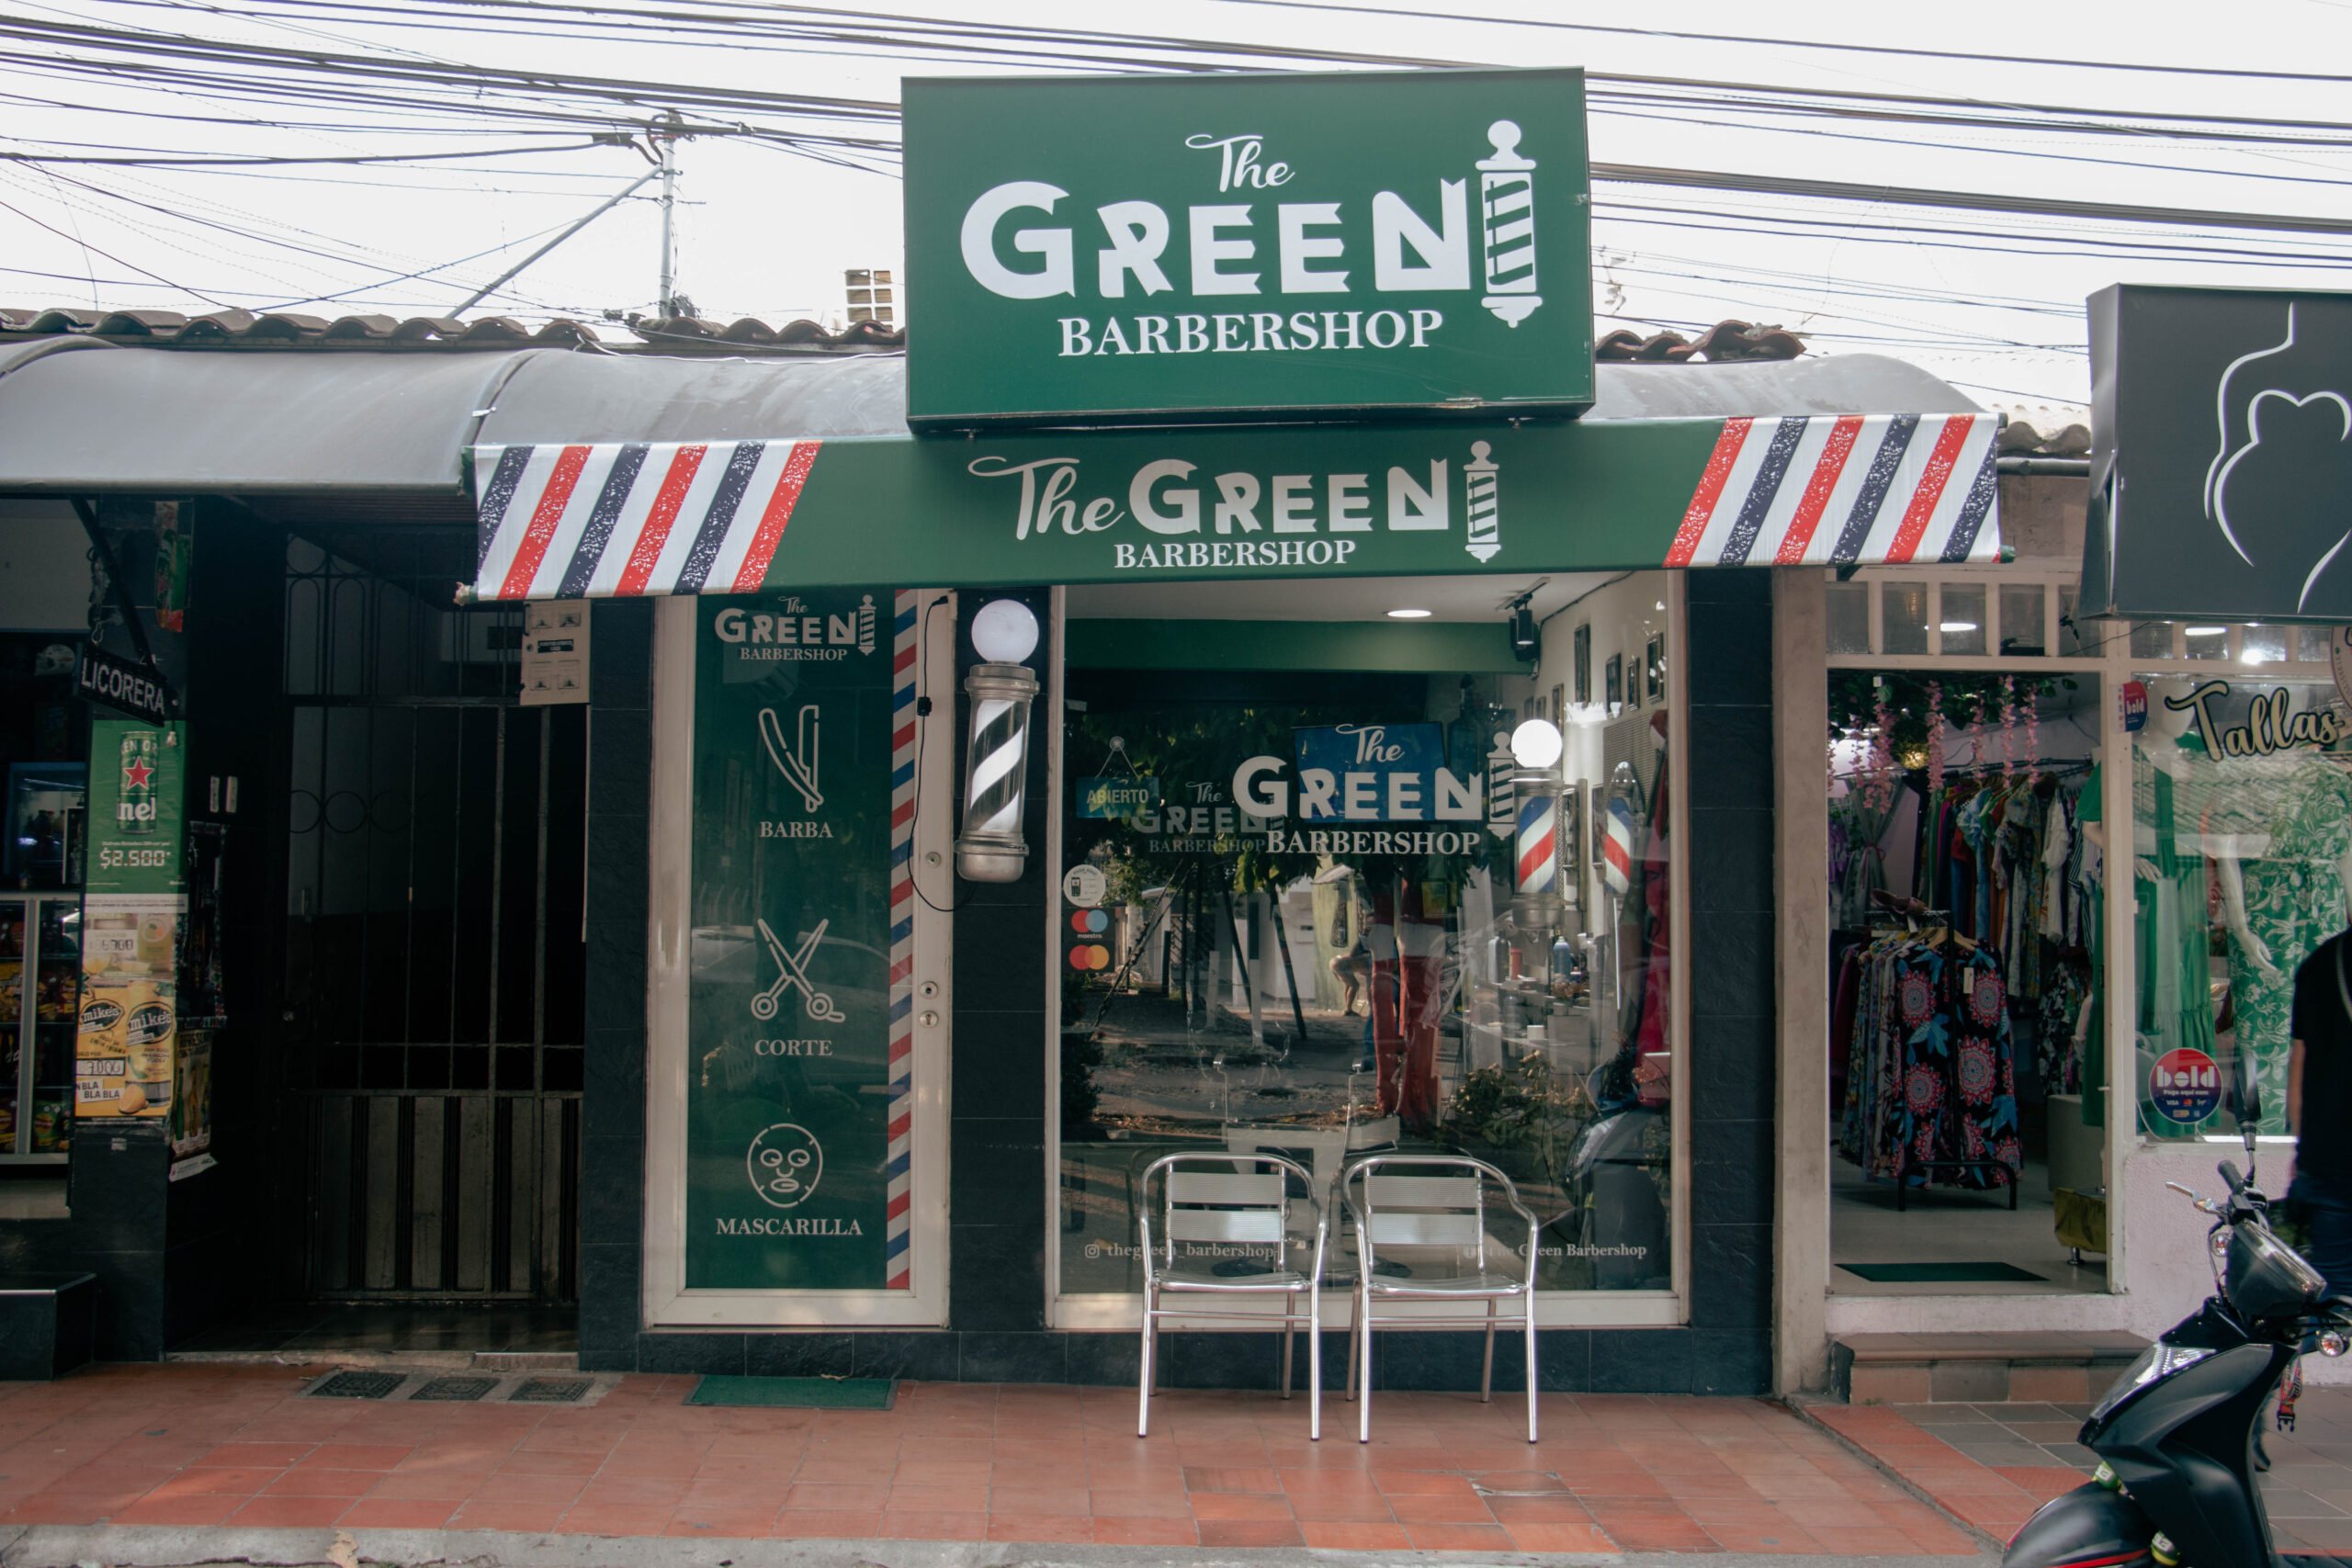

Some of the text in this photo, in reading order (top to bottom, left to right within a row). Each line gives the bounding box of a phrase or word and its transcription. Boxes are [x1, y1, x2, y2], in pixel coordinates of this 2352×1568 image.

[1184, 133, 1295, 193] The
[960, 178, 1471, 299] GREEN
[1057, 310, 1443, 356] BARBERSHOP
[967, 456, 1449, 540] The GREEN
[1114, 539, 1356, 569] BARBERSHOP
[778, 596, 808, 614] The
[714, 607, 857, 645] GREEN
[740, 647, 848, 661] BARBERSHOP
[81, 658, 164, 715] LICORERA
[2126, 697, 2144, 715] bold
[2165, 680, 2345, 761] Tallas
[1335, 723, 1406, 763] The
[1087, 788, 1148, 804] ABIERTO
[1232, 754, 1483, 820] GREEN
[760, 821, 833, 839] BARBA
[1266, 829, 1481, 856] BARBERSHOP
[83, 1006, 119, 1022] mike's
[130, 1010, 172, 1032] mike's
[753, 1039, 833, 1057] CORTE
[82, 1081, 99, 1090] BLA
[2156, 1065, 2215, 1088] bold
[84, 1090, 119, 1099] BLA BLA
[717, 1218, 863, 1235] MASCARILLA
[1519, 1243, 1562, 1257] Geen
[1566, 1243, 1646, 1259] Barbershop
